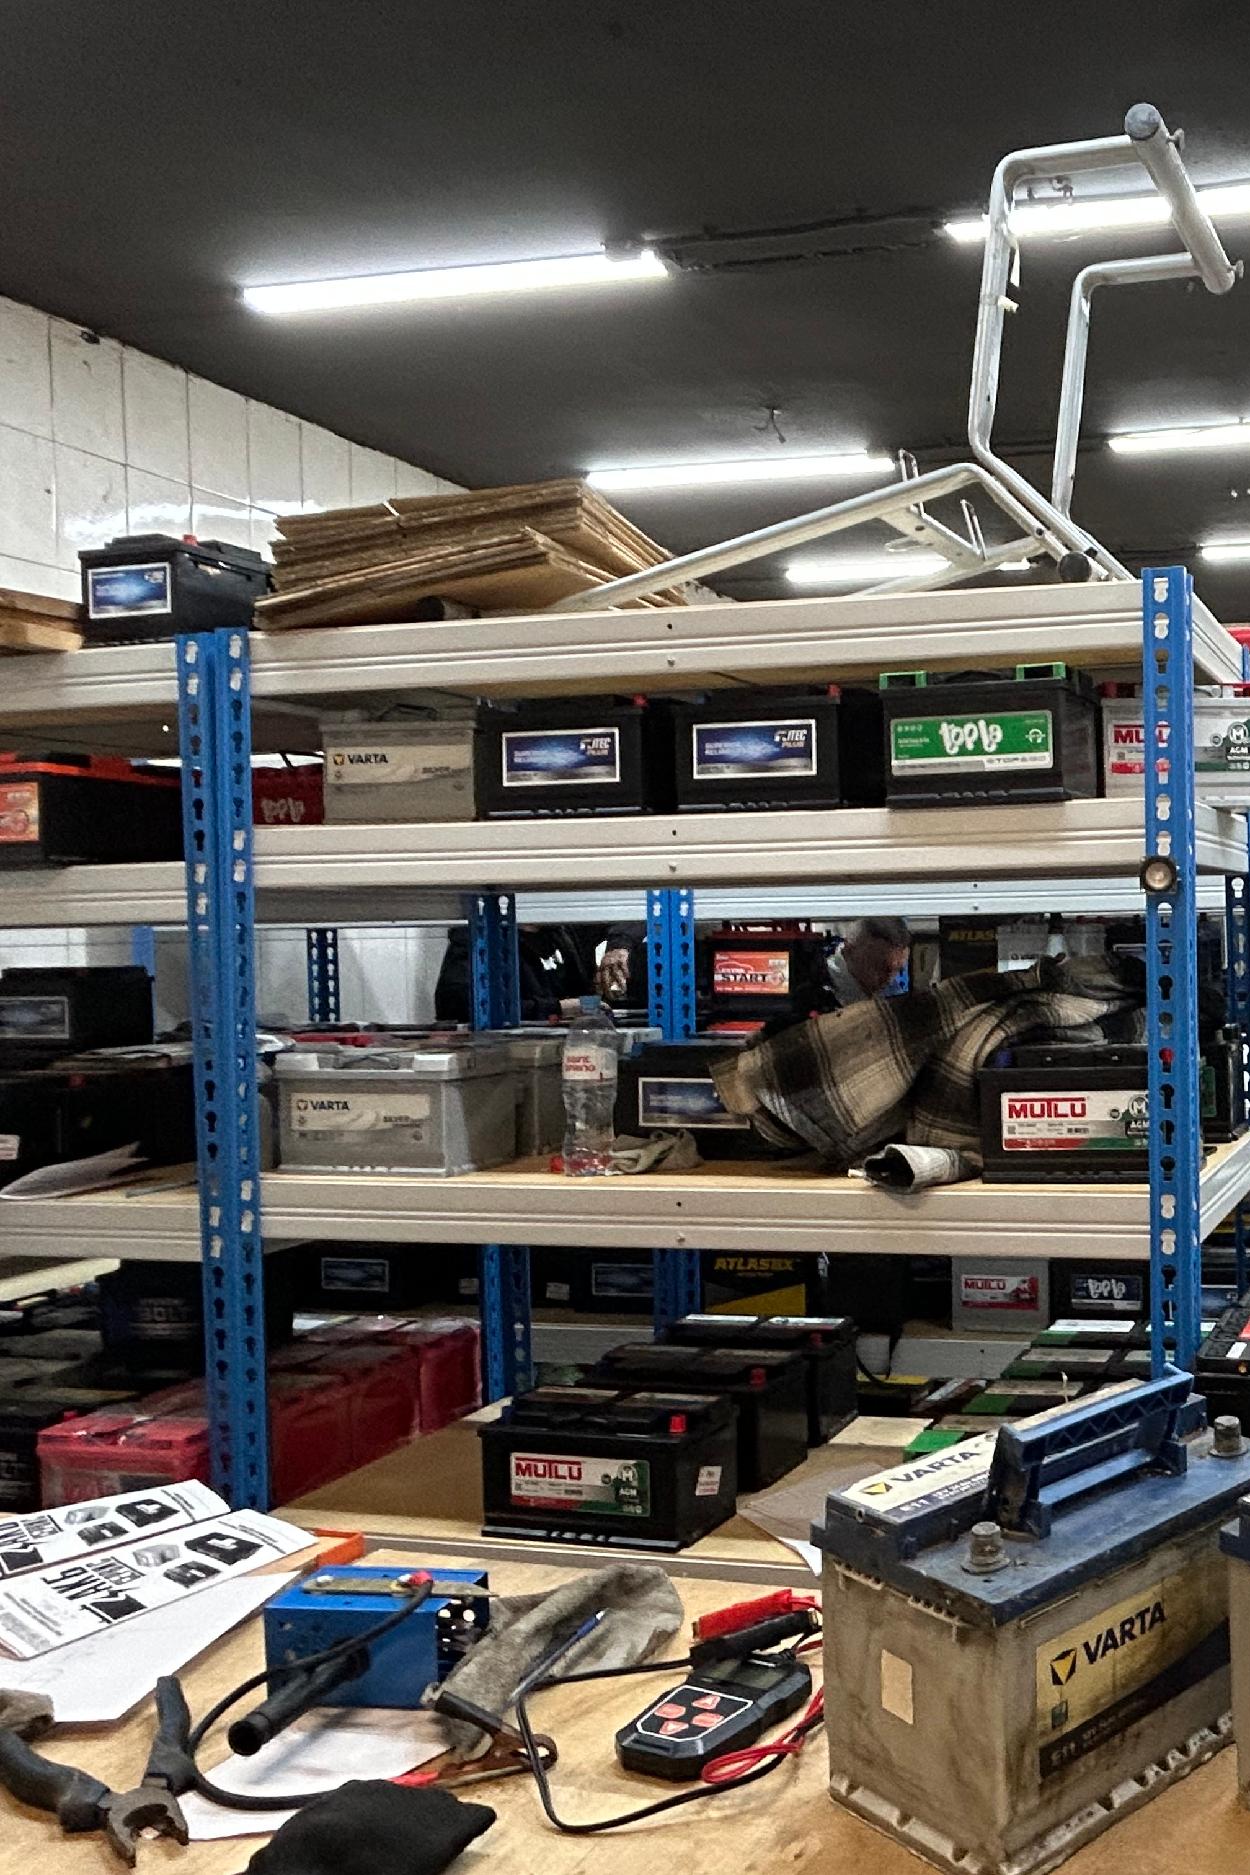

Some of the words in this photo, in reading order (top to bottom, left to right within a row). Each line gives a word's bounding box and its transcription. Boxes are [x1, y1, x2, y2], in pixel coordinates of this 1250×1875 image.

[347, 754, 388, 764] VARTA
[949, 929, 994, 941] ATLAS
[721, 972, 767, 983] START
[310, 1101, 350, 1111] VARTA
[1008, 1097, 1086, 1118] MUTLU
[964, 1278, 1007, 1290] MUTLU
[515, 1456, 582, 1480] MUTLU
[889, 1451, 983, 1482] VARTA
[1082, 1601, 1168, 1665] VARTA
